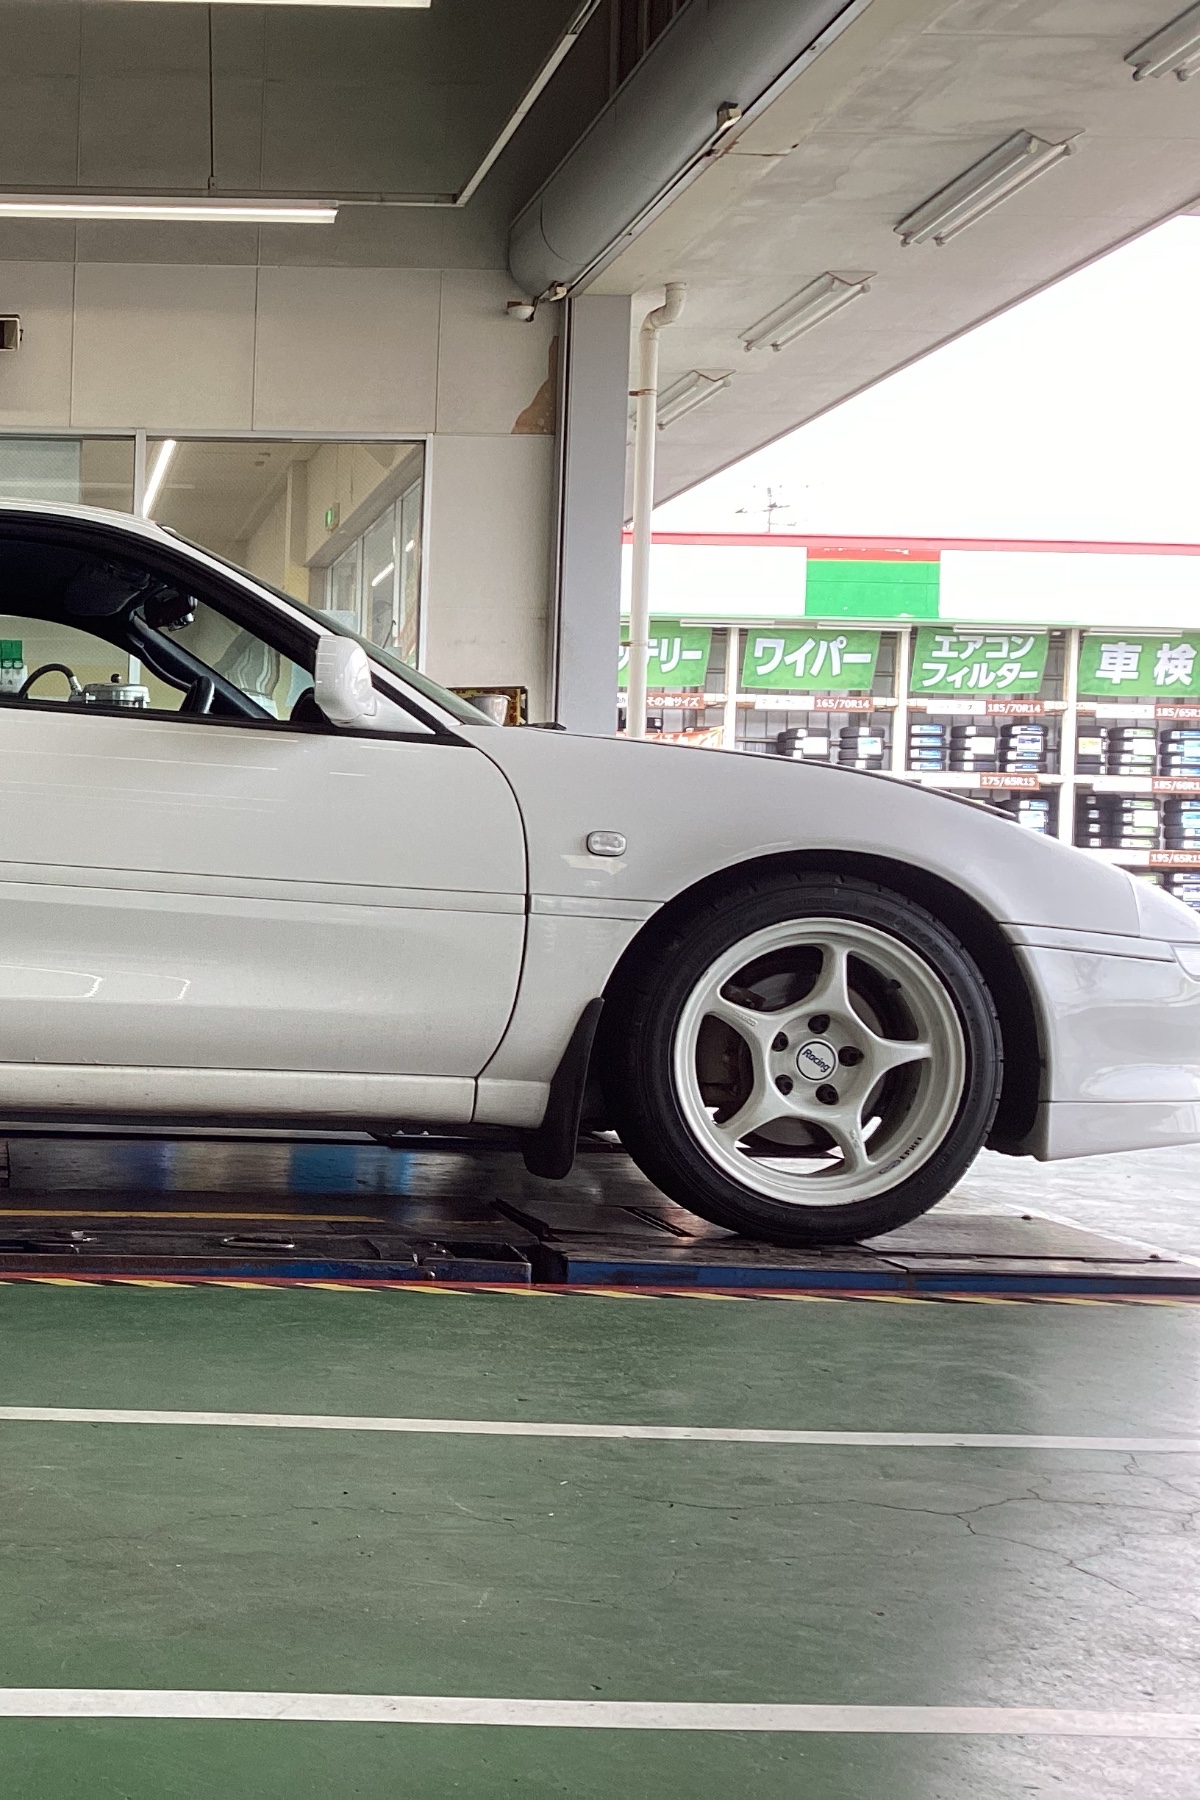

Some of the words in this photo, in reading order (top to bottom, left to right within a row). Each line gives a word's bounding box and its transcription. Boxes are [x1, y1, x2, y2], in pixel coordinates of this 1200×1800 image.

[753, 635, 872, 678] ワイパー
[931, 634, 1035, 661] エアコン
[921, 662, 1039, 689] フィルター
[1095, 641, 1198, 686] 車検
[816, 698, 871, 711] 165/70R14
[987, 702, 1042, 714] 185/70R14
[981, 775, 1036, 788] 175/65R15
[802, 1048, 831, 1073] Racing
